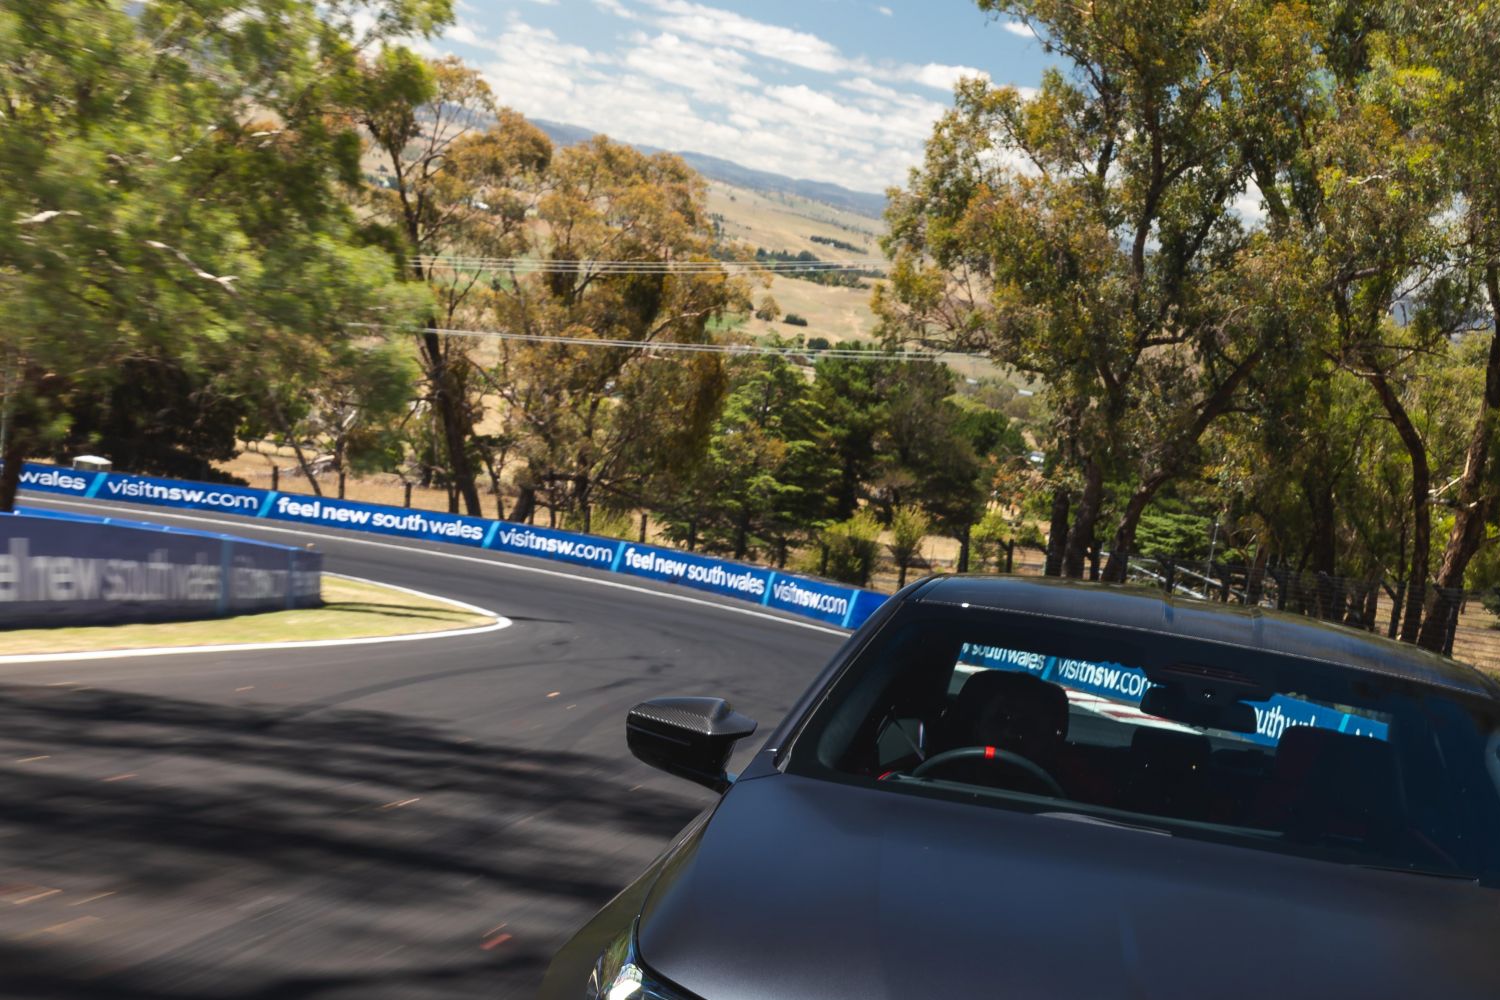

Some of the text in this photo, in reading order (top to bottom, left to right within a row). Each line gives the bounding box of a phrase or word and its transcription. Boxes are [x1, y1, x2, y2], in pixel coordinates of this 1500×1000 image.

[107, 479, 259, 510] visitnsw.com
[277, 498, 484, 540] feel new south wales
[500, 528, 612, 563] visitnsw.com
[625, 547, 765, 596] feel new south wales
[773, 580, 848, 616] visitnsw.com
